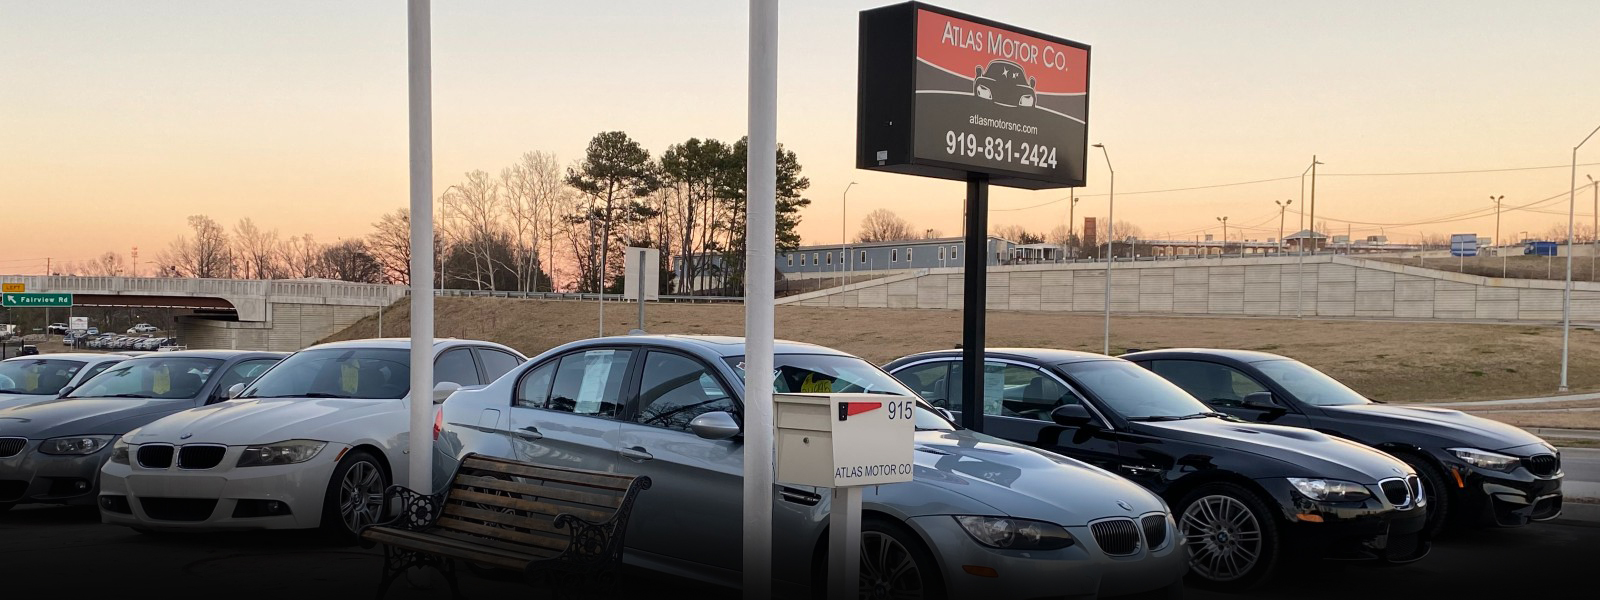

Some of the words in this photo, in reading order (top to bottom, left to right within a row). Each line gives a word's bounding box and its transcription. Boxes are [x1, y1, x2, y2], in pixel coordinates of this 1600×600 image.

[942, 21, 983, 51] ATLAS
[988, 31, 1038, 65] MOTOR
[1043, 45, 1068, 71] CO.
[969, 114, 1038, 135] atlasmotorsnc.com
[946, 130, 1057, 169] 919-831-2424
[888, 401, 913, 420] 915
[834, 466, 863, 478] ATLAS
[865, 464, 896, 477] MOTOR
